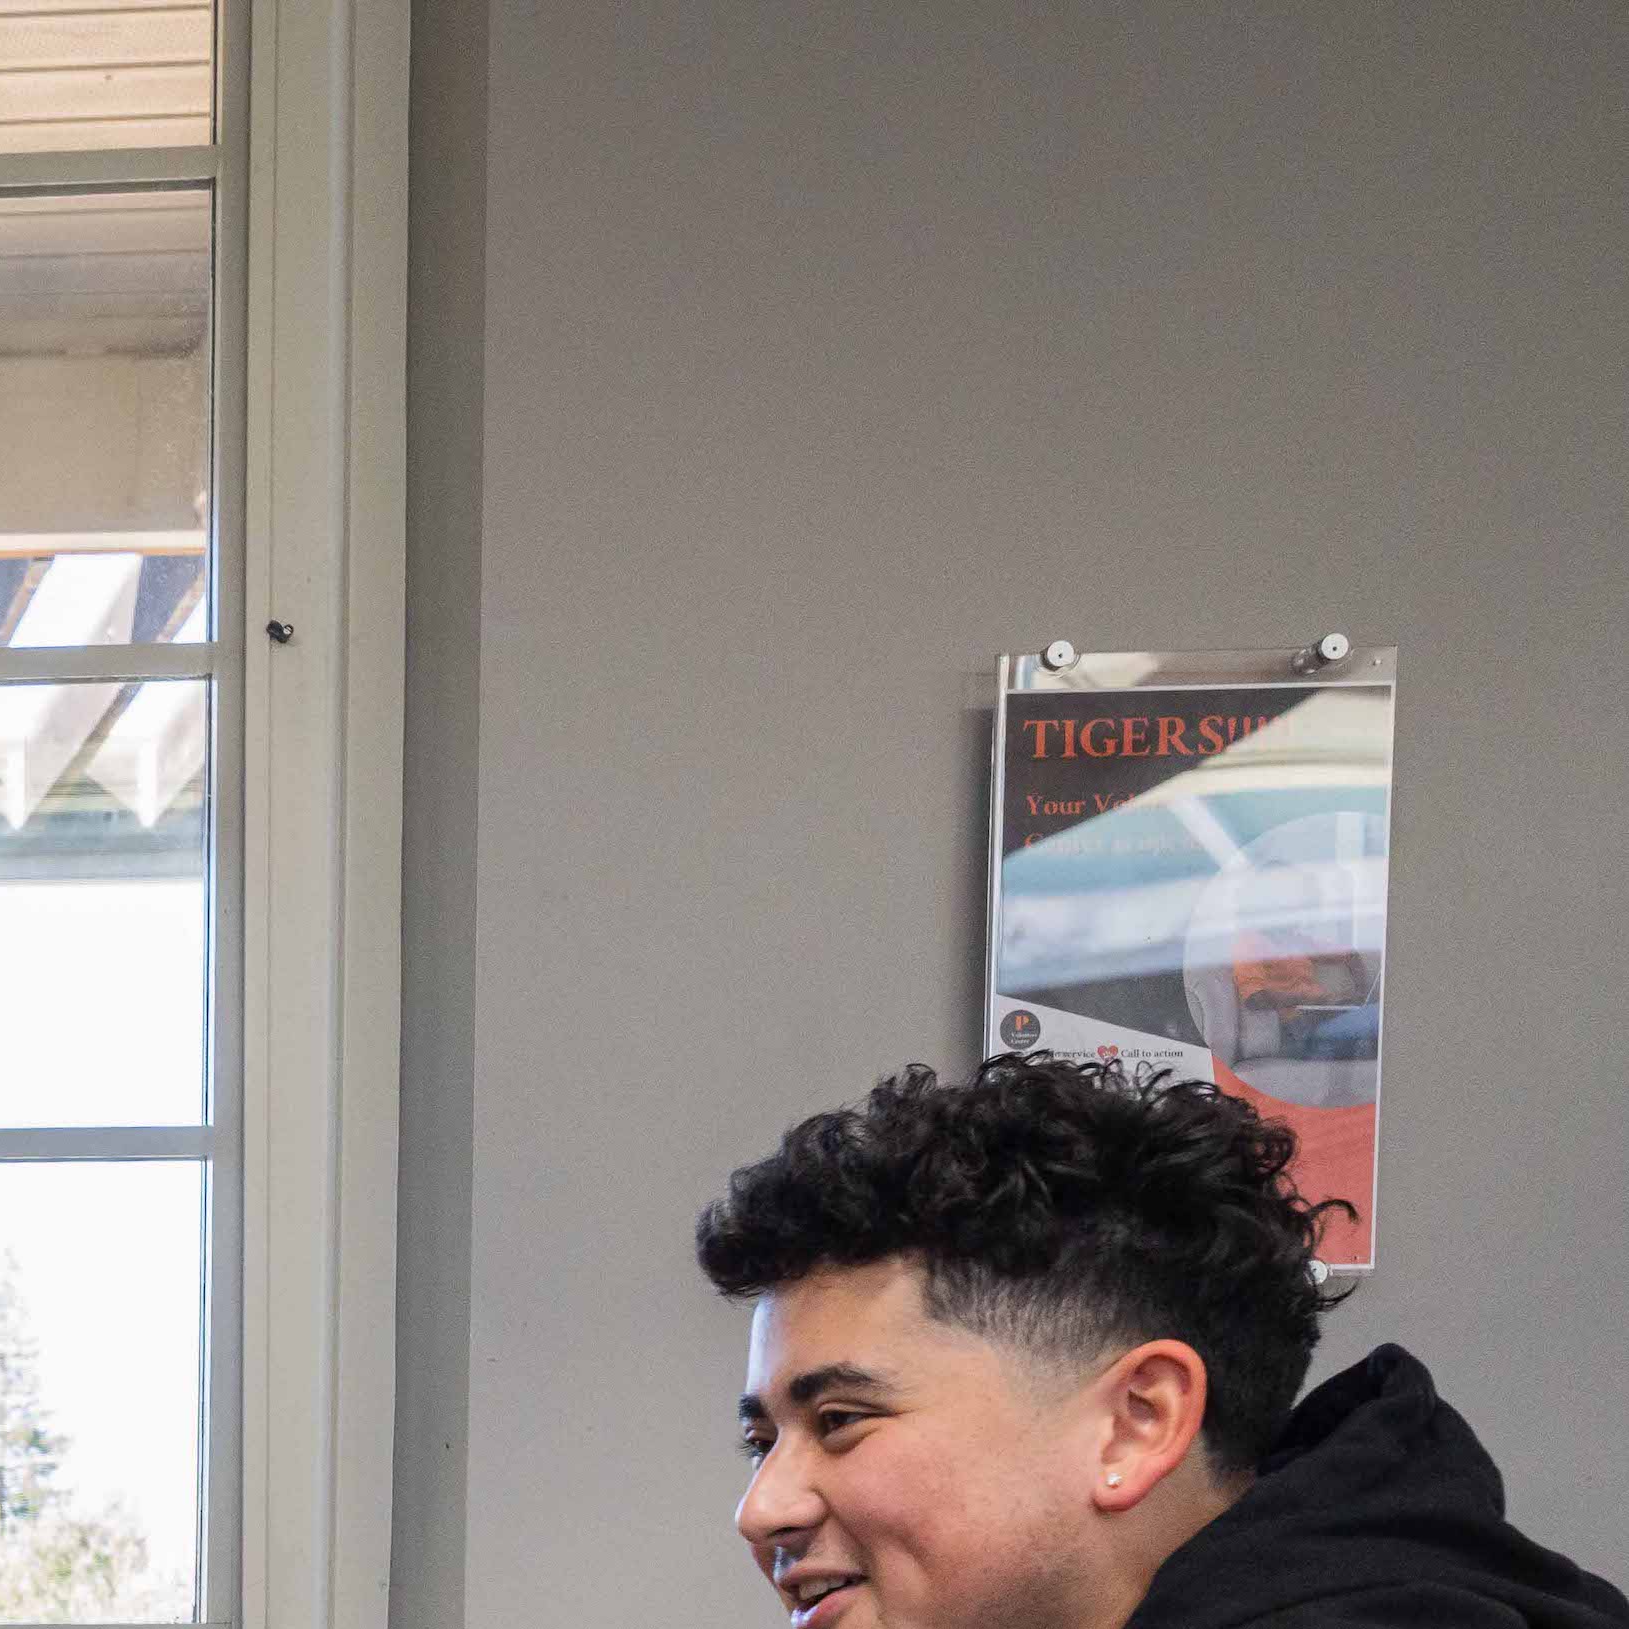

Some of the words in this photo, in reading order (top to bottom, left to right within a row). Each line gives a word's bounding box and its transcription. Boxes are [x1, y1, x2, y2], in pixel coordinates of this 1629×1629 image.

[1026, 792, 1085, 816] Your
[1121, 1048, 1140, 1058] Call
[1142, 1049, 1152, 1058] to
[1154, 1049, 1184, 1058] action
